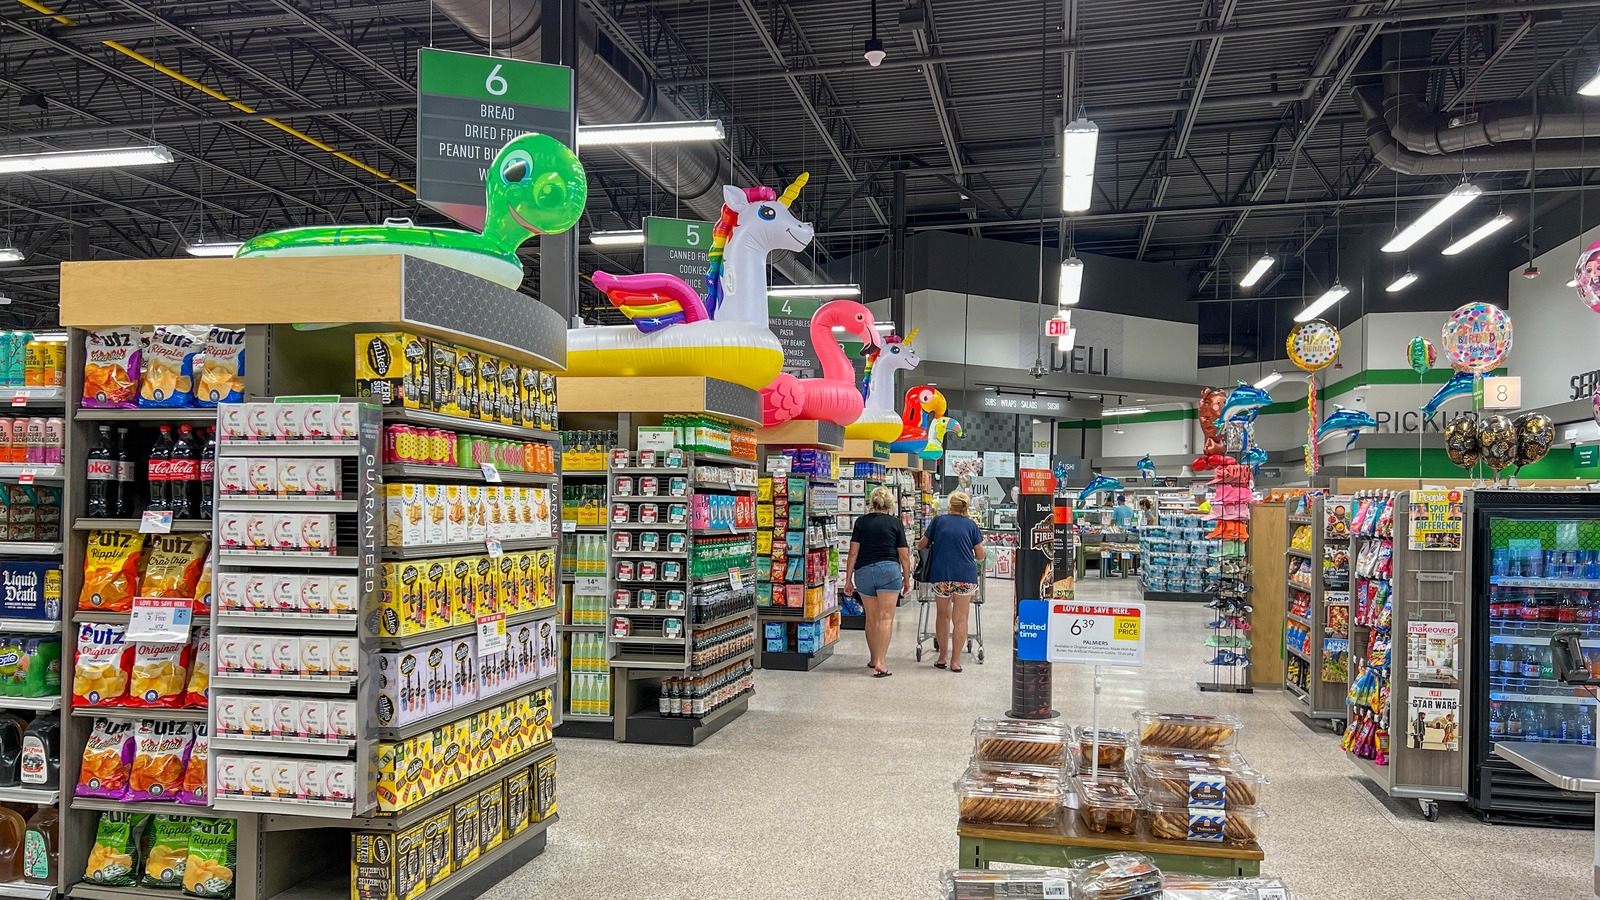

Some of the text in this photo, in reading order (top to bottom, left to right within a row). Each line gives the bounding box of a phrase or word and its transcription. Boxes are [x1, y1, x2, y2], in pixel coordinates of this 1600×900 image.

[485, 64, 508, 96] 6
[480, 104, 515, 121] BREAD
[465, 124, 497, 140] DRIED
[439, 142, 481, 160] PEANUT
[686, 225, 700, 246] 5
[670, 250, 710, 262] CANNED FRU
[679, 264, 707, 275] COOKIES
[685, 279, 702, 288] UICE
[782, 300, 793, 315] 4
[769, 318, 810, 328] NNED VEGETABLES
[1050, 321, 1067, 335] EXIT
[102, 332, 132, 347] utz
[162, 330, 194, 348] utz
[217, 330, 245, 345] utz
[780, 329, 794, 337] PASTA
[783, 349, 804, 357] S/MIXES
[1051, 343, 1109, 376] DELI
[783, 359, 811, 367] G/POTATOES
[381, 380, 391, 404] ZERO
[1570, 370, 1600, 401] SER
[1497, 385, 1508, 402] 8
[984, 398, 1060, 410] SUBS WRAPS SALADS SUSHI
[1033, 440, 1051, 448] mer
[88, 462, 112, 474] oke
[972, 484, 989, 495] YUM
[1418, 493, 1447, 504] People
[1430, 505, 1448, 513] SPOT
[365, 454, 375, 594] GUARANTEED
[1431, 513, 1445, 521] THE
[1416, 522, 1460, 530] DIFFERENCE
[99, 531, 132, 548] utz
[162, 537, 193, 554] utz
[3, 570, 38, 590] Liquid
[4, 586, 37, 602] Death
[1020, 622, 1046, 631] limited
[1410, 626, 1456, 634] makeovers
[93, 628, 125, 645] utz
[1020, 631, 1038, 639] time
[138, 643, 180, 657] Original
[1413, 700, 1457, 710] STAR WARS
[154, 721, 187, 736] utz
[159, 825, 192, 837] Ripple
[193, 834, 227, 846] Ripples
[361, 835, 369, 864] SELTZER
